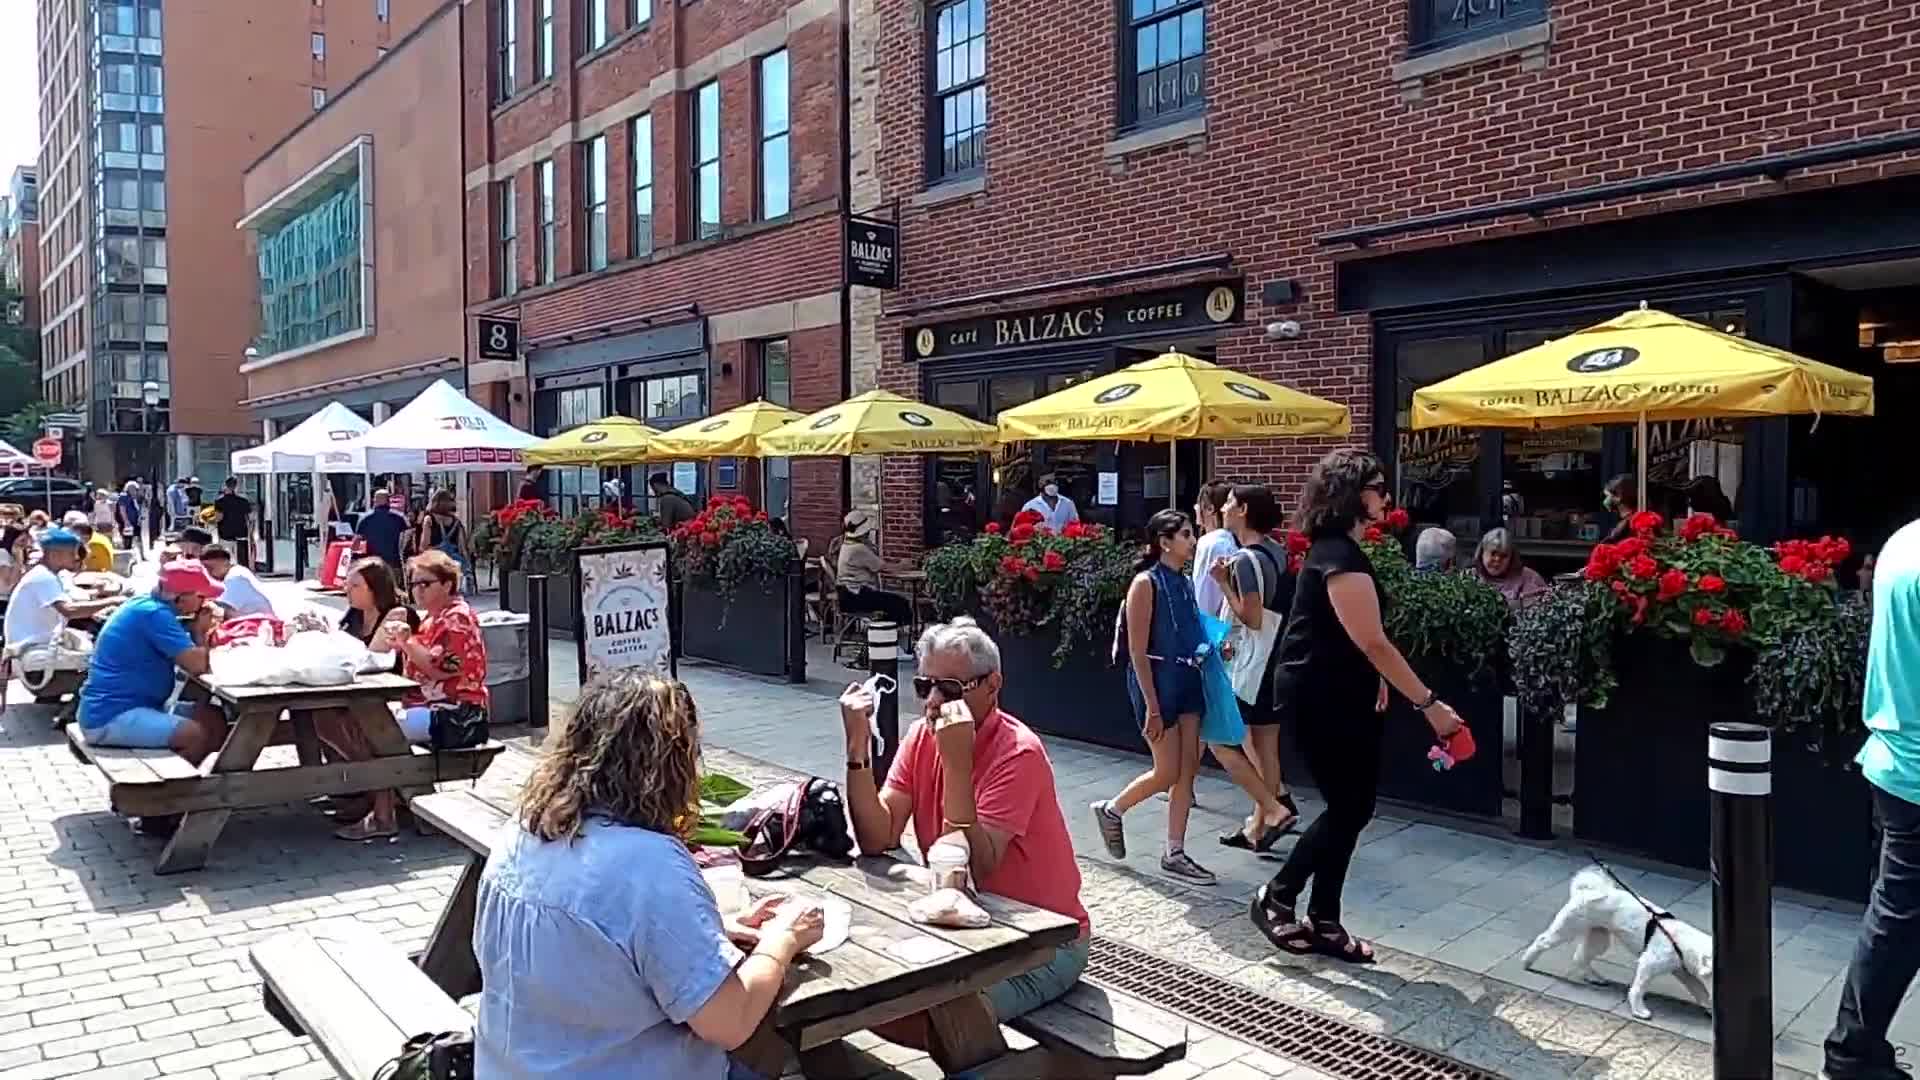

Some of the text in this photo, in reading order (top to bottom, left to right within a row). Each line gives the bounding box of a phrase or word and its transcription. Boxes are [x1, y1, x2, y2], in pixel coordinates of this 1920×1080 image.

[1127, 303, 1183, 323] COFFEE
[490, 324, 508, 350] 8
[1480, 395, 1524, 407] COFFEE
[611, 637, 641, 647] COFFEE
[607, 643, 648, 655] ROASTERS
